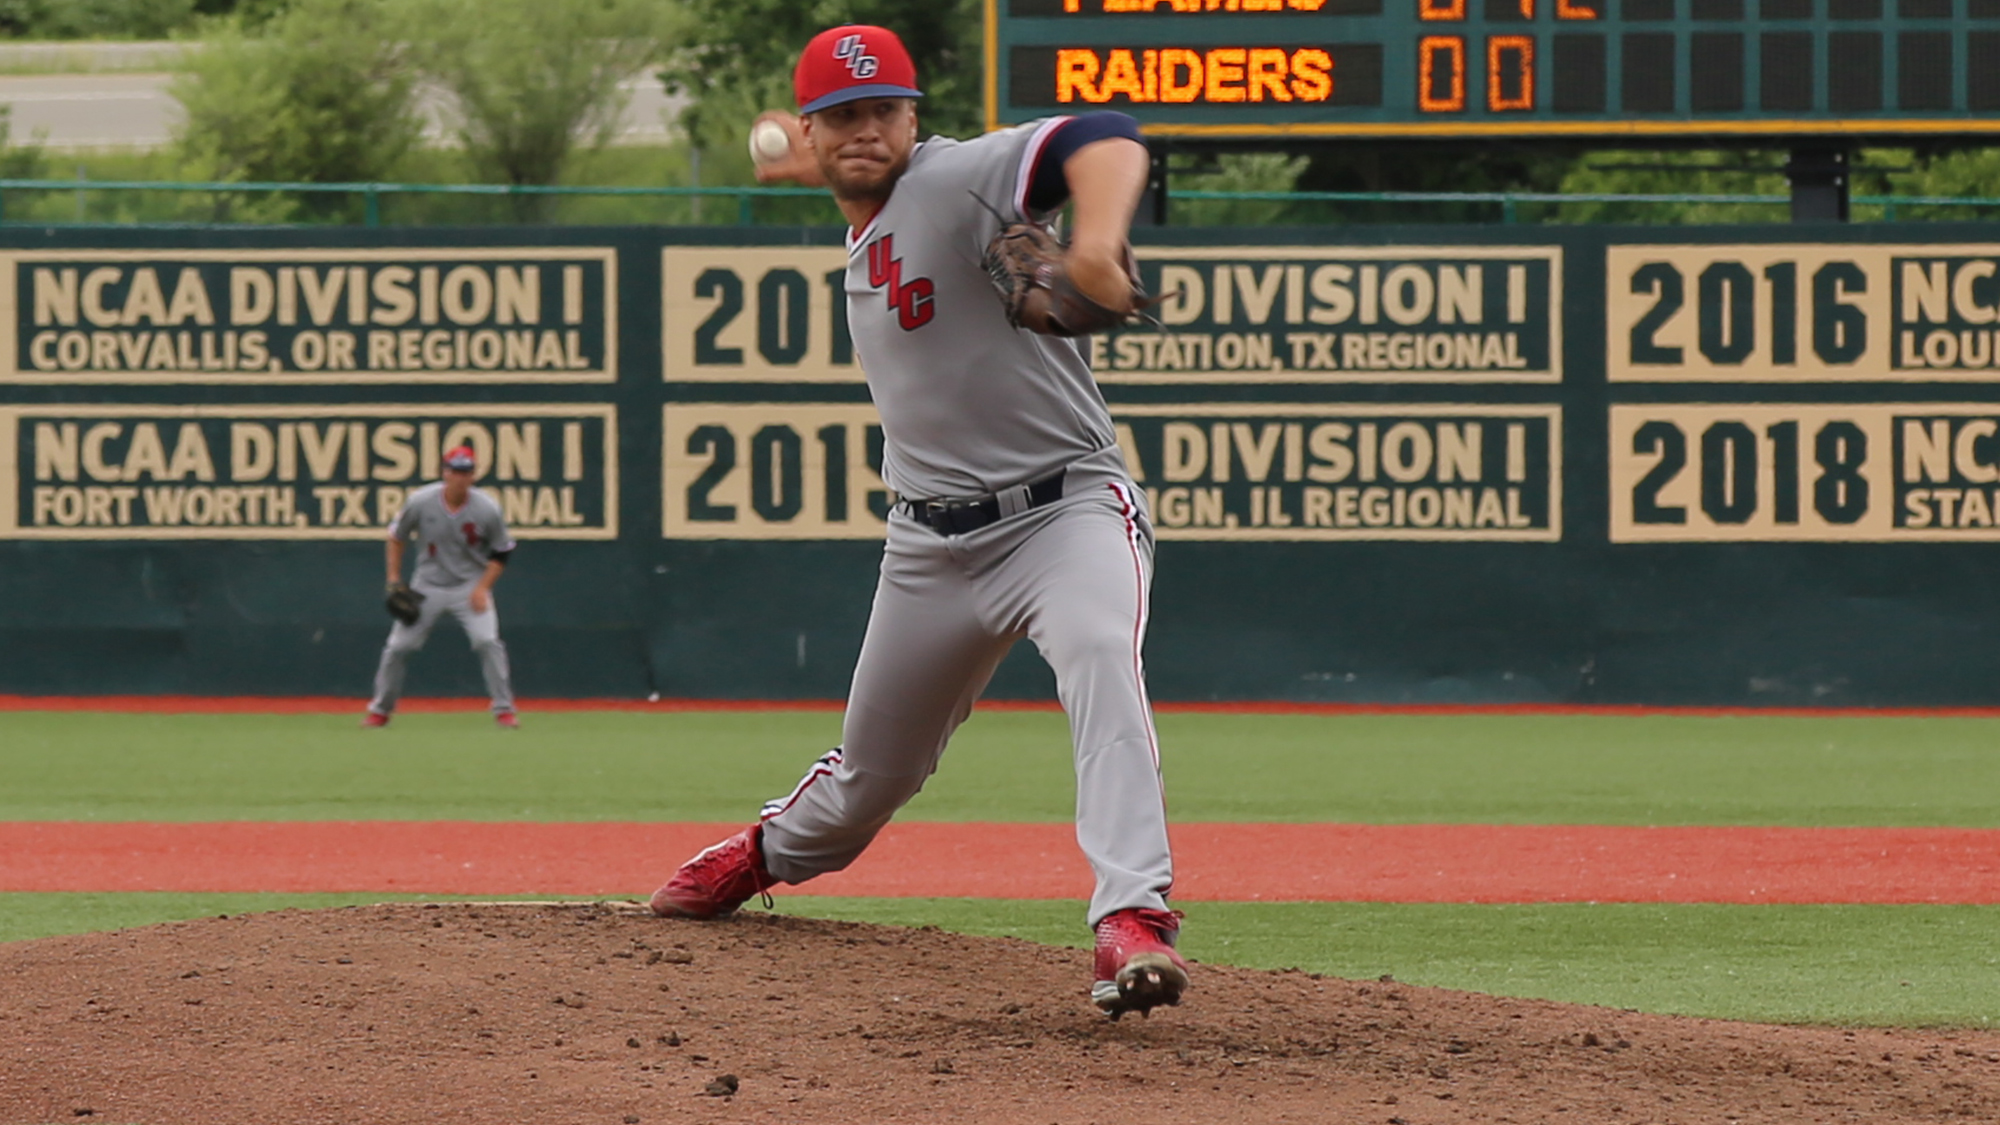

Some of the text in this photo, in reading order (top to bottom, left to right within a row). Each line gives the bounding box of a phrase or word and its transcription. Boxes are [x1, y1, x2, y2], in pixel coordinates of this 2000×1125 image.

[832, 33, 880, 80] UIC
[1056, 36, 1533, 111] RAIDERS 0 0
[35, 266, 582, 326] NCAA DIVISION I
[868, 233, 935, 332] UIC
[1158, 265, 1525, 324] DIVISION I
[1902, 261, 2000, 323] NC
[695, 268, 853, 365] 201
[1630, 262, 1866, 364] 2016
[31, 330, 588, 370] CORVALLIS, OR REGIONAL
[1114, 334, 1282, 369] STATION,
[1287, 333, 1336, 368] TX
[1343, 333, 1526, 368] REGIONAL
[35, 422, 582, 483] NCAA DIVISION I
[1164, 423, 1481, 482] DIVISION
[1507, 425, 1525, 481] I
[1633, 421, 1868, 524] 2018
[1904, 420, 2000, 482] NC
[35, 487, 138, 526] FORT
[144, 487, 309, 528] WORTH,
[313, 487, 368, 525] TX
[1251, 488, 1291, 528] IL
[1304, 488, 1530, 527] REGIONAL
[1905, 489, 2000, 527] STA
